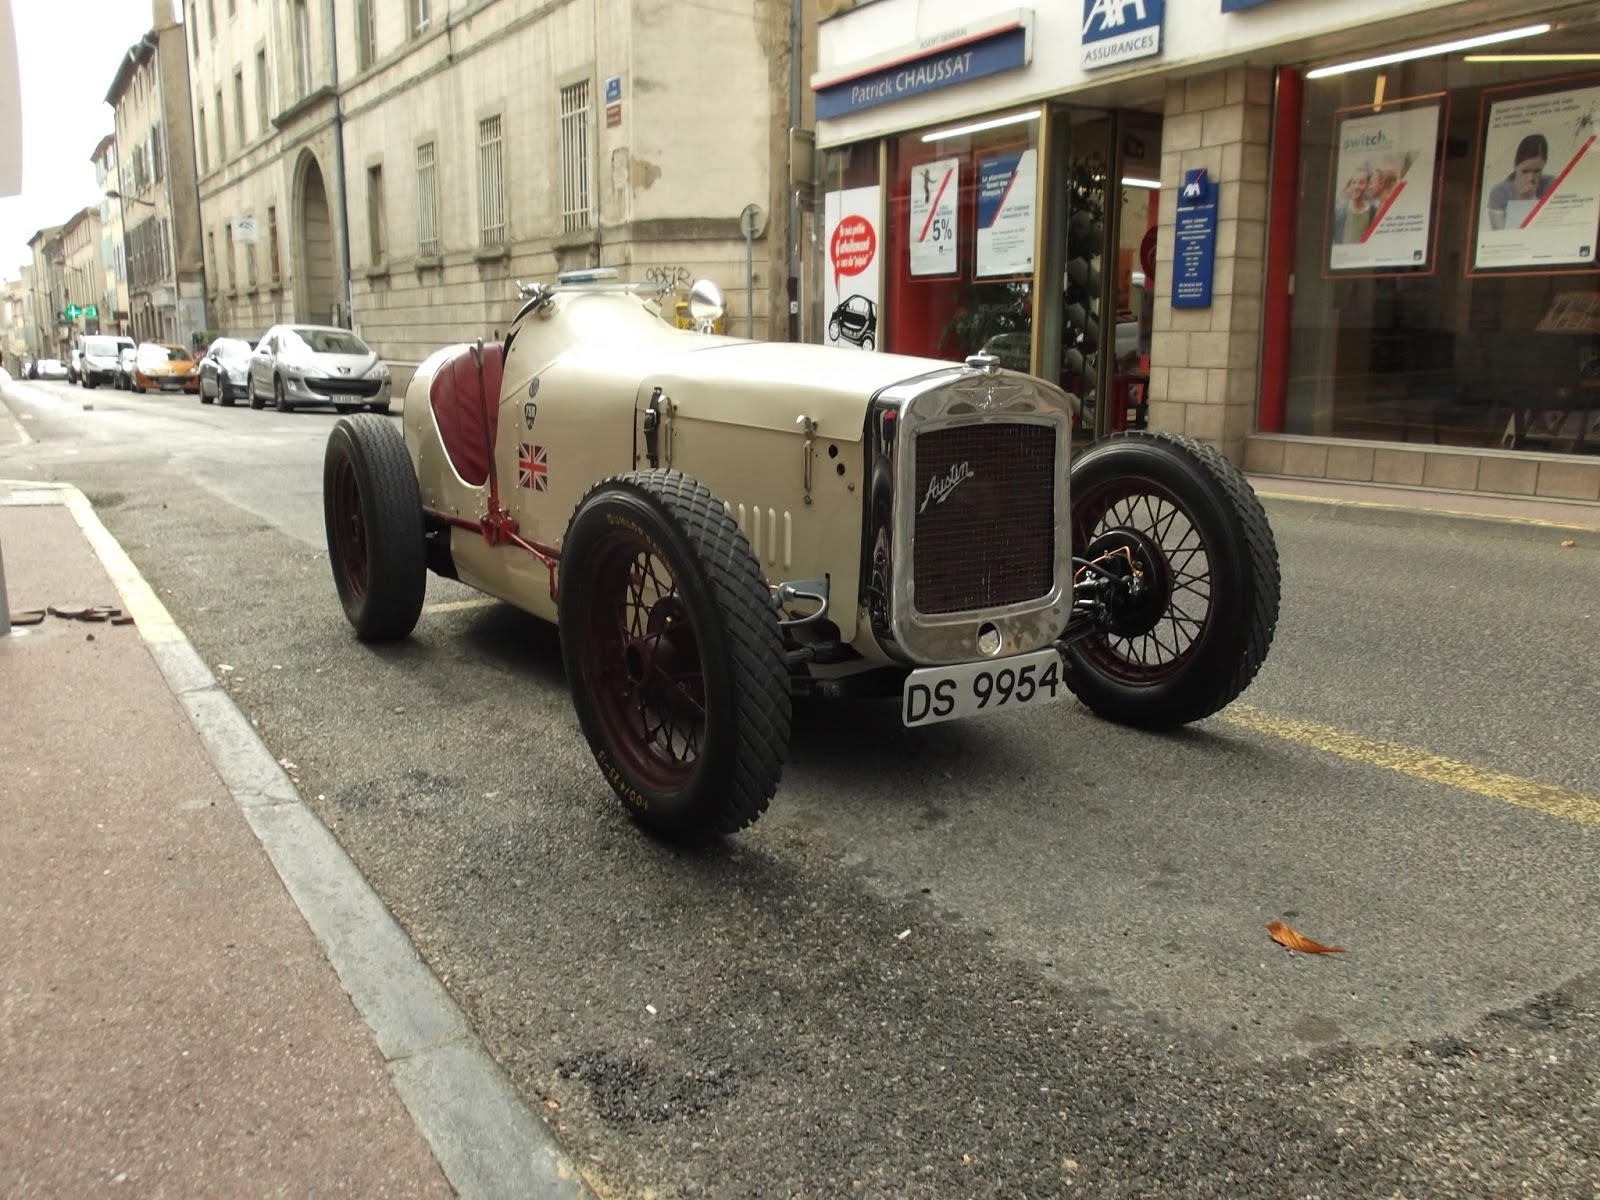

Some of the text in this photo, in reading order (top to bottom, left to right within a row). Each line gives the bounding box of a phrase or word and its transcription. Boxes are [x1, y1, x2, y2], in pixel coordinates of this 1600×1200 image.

[1084, 34, 1155, 62] ASSURANCES
[851, 51, 973, 105] Patrick CHAUSSAT
[932, 217, 953, 242] 5%
[919, 461, 975, 514] Austin
[906, 661, 1059, 724] DS 9954
